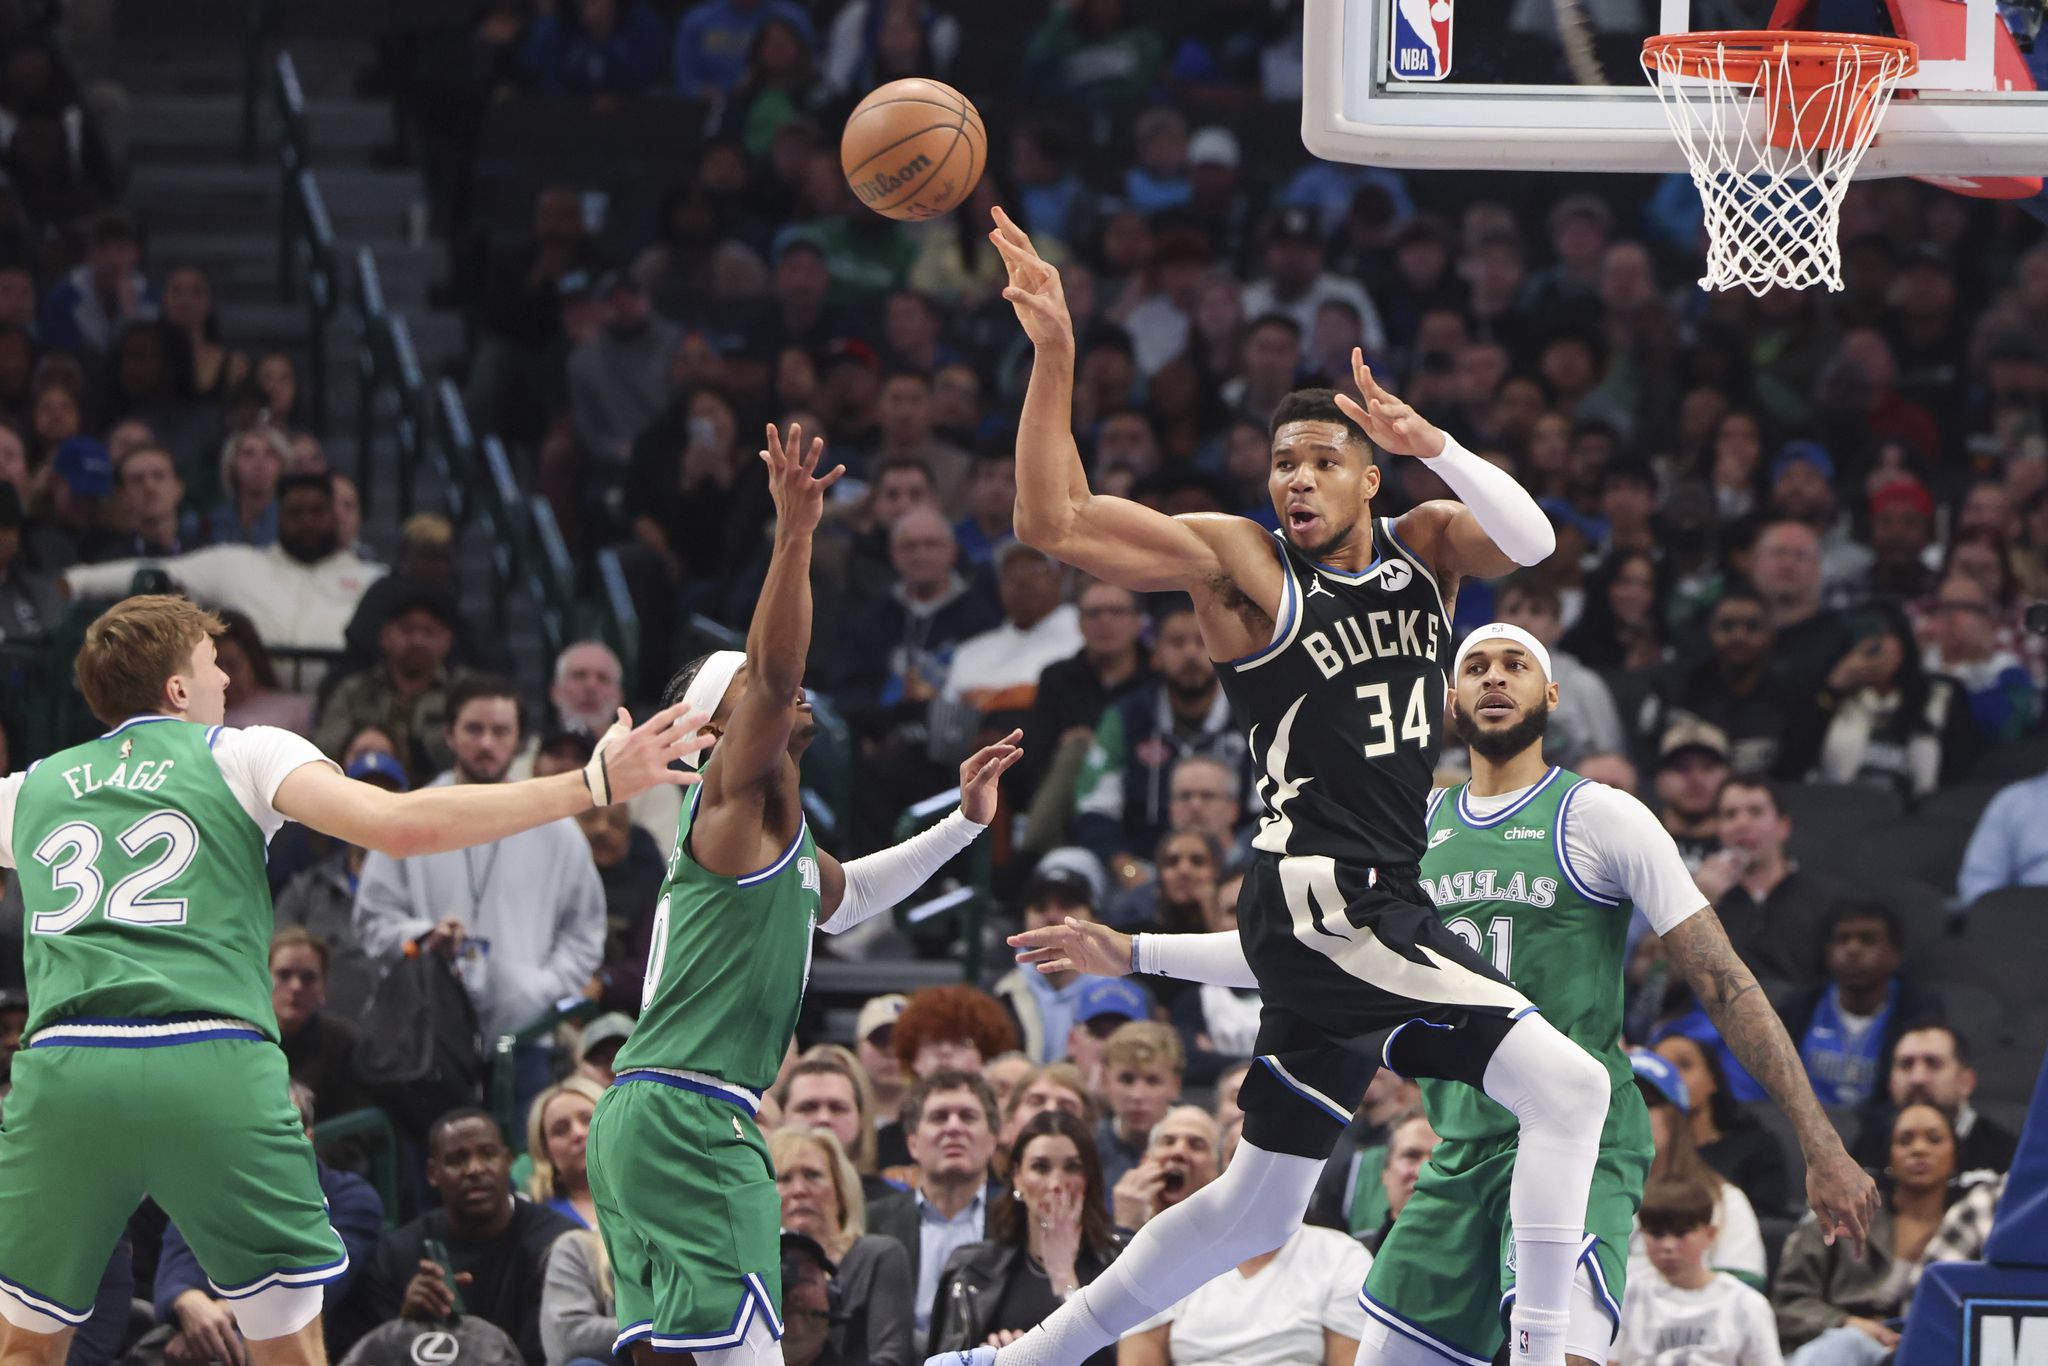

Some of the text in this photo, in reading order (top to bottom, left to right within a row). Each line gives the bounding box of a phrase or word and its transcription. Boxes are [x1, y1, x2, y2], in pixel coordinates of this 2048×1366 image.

[1400, 48, 1428, 70] NBA
[853, 154, 932, 203] Wilson
[1301, 609, 1439, 680] BUCKS
[1355, 675, 1430, 758] 34
[62, 760, 174, 799] FLAGG
[1504, 826, 1545, 840] chime
[31, 808, 199, 935] 32
